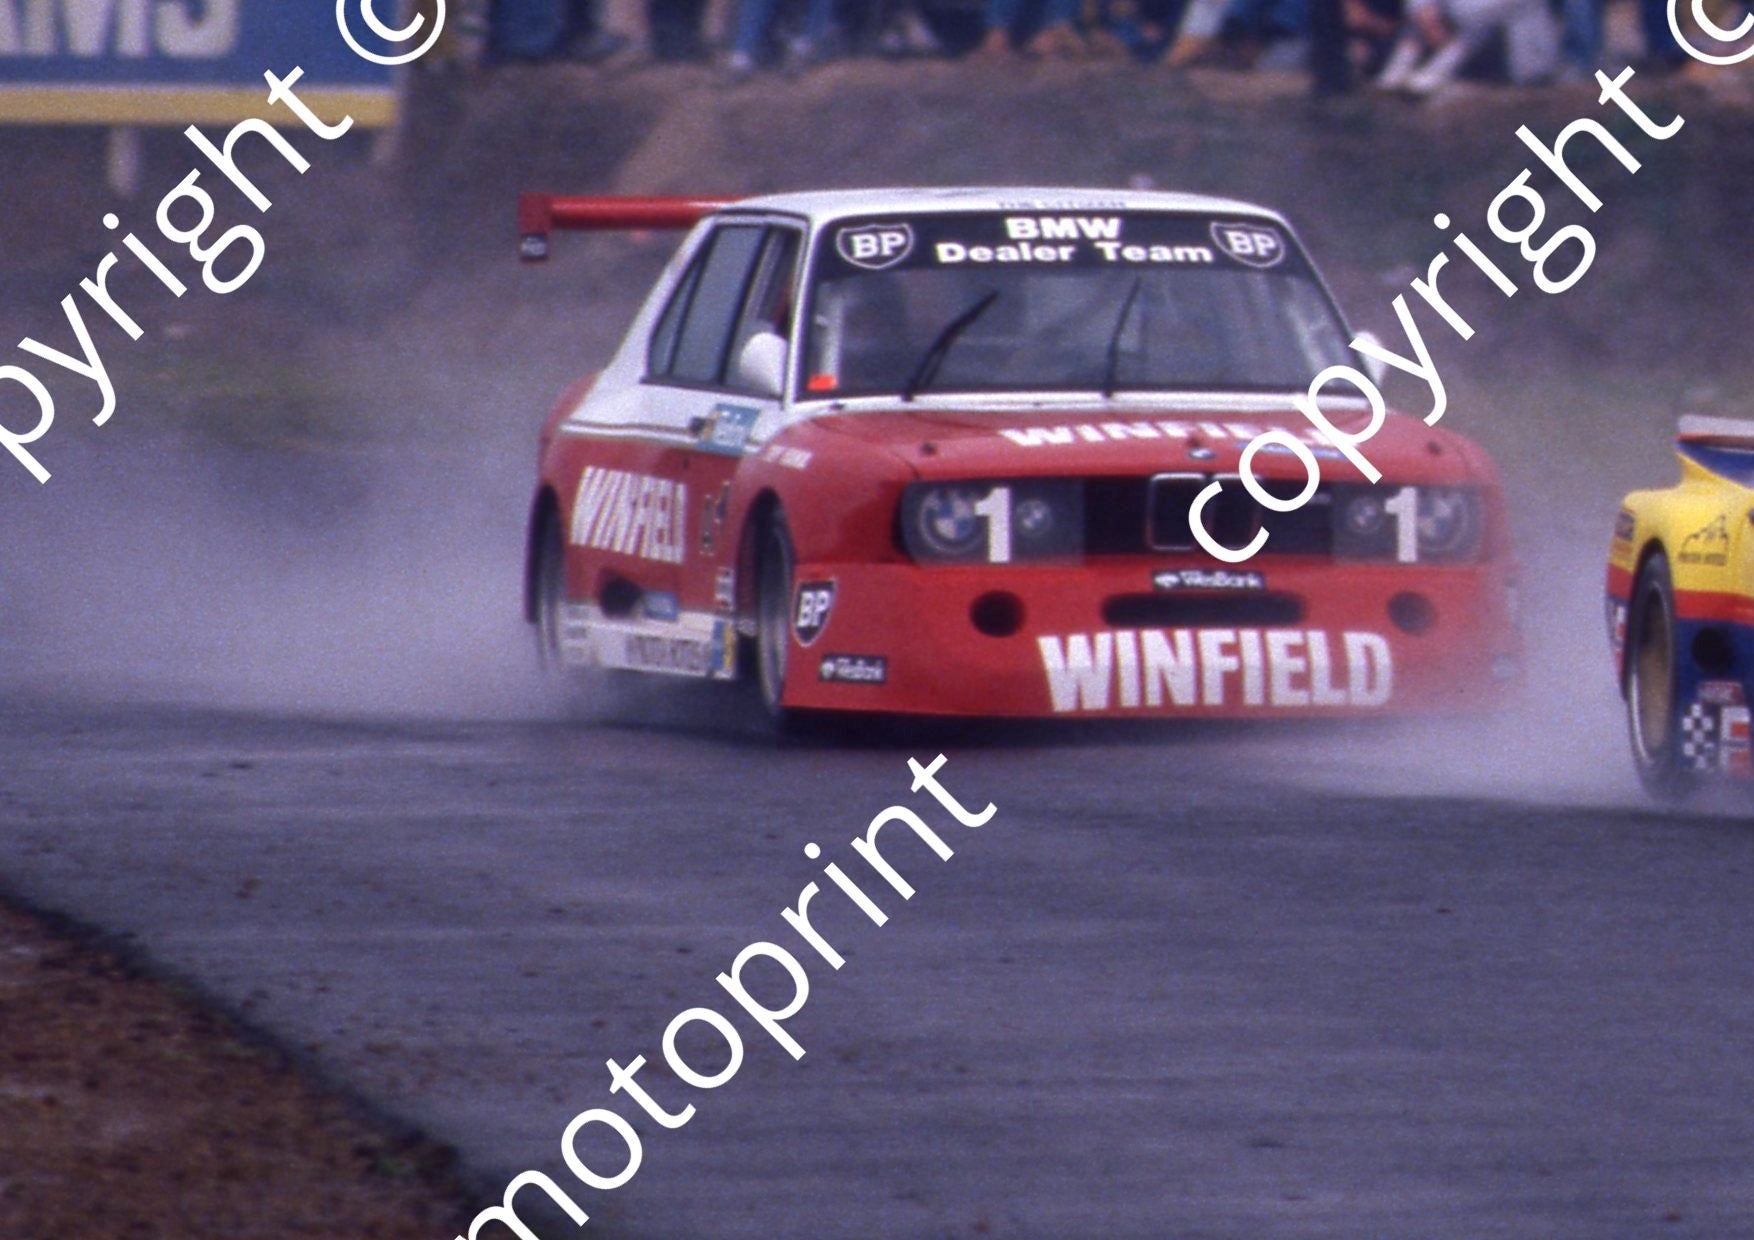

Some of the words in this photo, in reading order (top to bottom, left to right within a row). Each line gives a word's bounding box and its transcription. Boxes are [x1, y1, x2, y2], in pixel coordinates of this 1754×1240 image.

[1005, 216, 1122, 239] BMW
[1227, 230, 1277, 258] BP
[851, 231, 905, 260] BP
[934, 242, 1075, 262] Dealer
[1093, 241, 1214, 262] Team
[974, 487, 1010, 563] 1
[1386, 487, 1418, 563] 1
[797, 591, 831, 628] BP
[1037, 628, 1393, 712] WINFIELD
